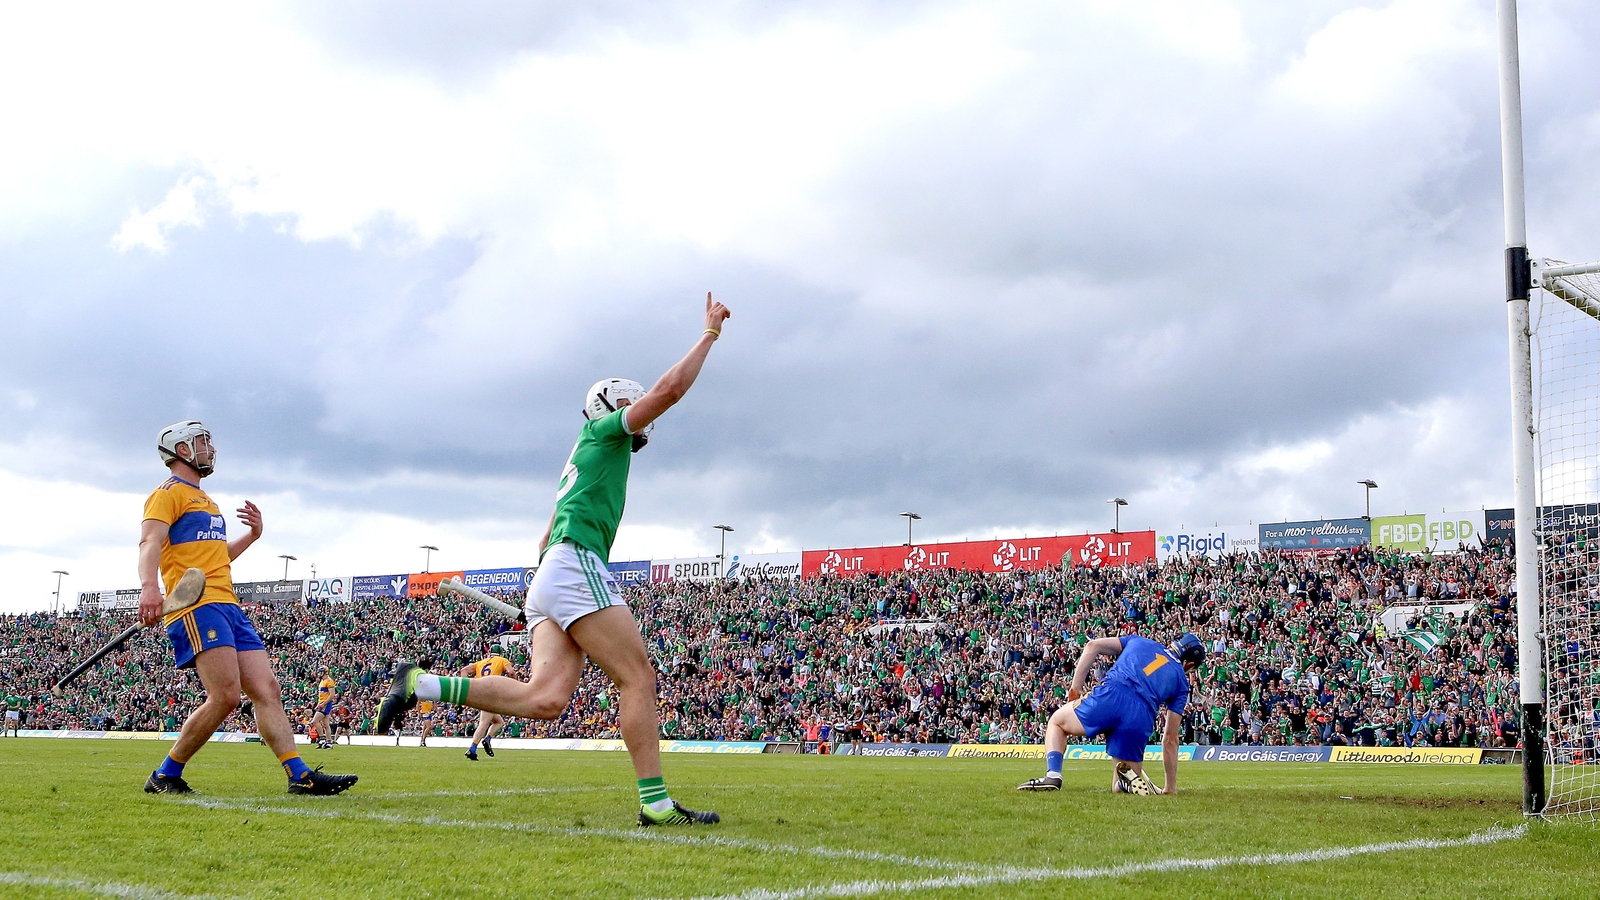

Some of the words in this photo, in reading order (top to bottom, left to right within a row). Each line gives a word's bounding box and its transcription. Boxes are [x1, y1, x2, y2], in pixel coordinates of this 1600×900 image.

[197, 530, 210, 540] Pat
[1349, 527, 1364, 536] stay
[1380, 524, 1422, 543] FBD
[1429, 520, 1474, 541] FBD
[1108, 541, 1132, 556] LIT
[1177, 533, 1225, 554] Rigid
[1231, 538, 1257, 547] Ireland
[928, 551, 950, 566] LIT
[1019, 546, 1042, 561] LIT
[762, 562, 799, 575] Cement
[843, 556, 864, 570] LIT
[465, 572, 521, 585] REGENERON
[652, 564, 673, 583] UL
[674, 562, 720, 577] SPORT
[481, 663, 492, 677] 6
[1143, 653, 1170, 677] 1
[669, 743, 713, 753] Centra
[715, 744, 761, 754] Centra
[861, 747, 885, 757] Bord
[1218, 750, 1249, 761] Bord
[1250, 749, 1278, 761] Gáis
[1278, 750, 1324, 763] Energy
[1336, 749, 1421, 762] Littlewoods
[1421, 752, 1474, 764] Ireland
